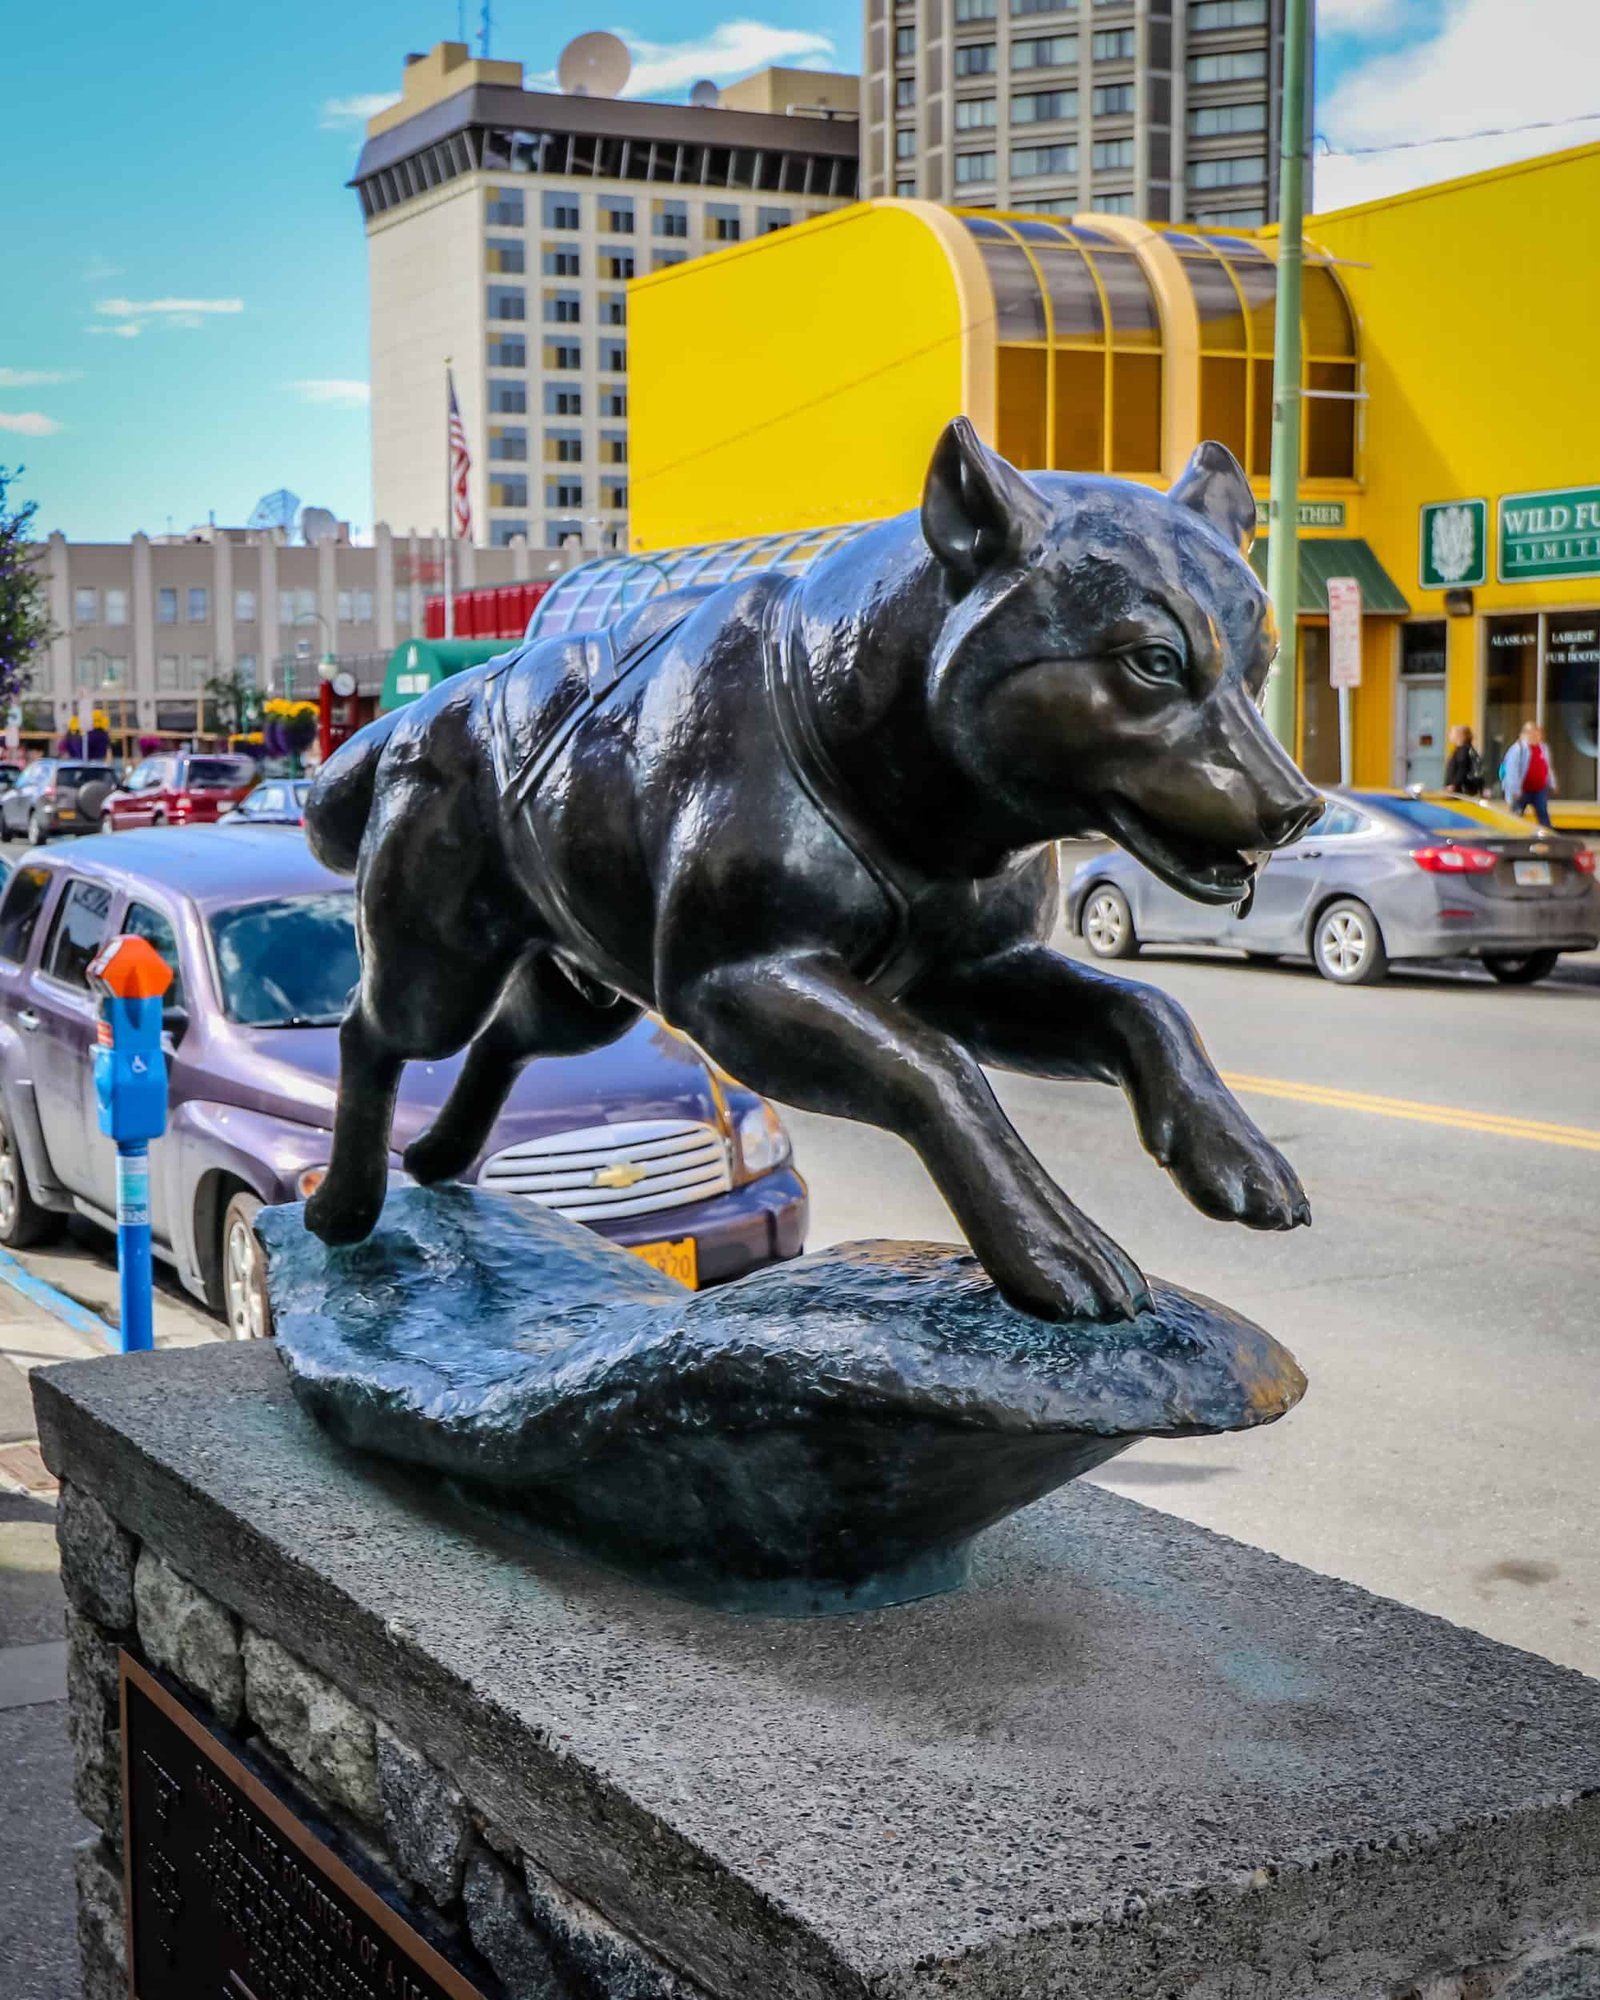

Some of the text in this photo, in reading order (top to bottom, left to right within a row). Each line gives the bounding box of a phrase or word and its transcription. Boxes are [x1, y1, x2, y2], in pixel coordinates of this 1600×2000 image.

[1296, 506, 1341, 523] THER
[1504, 506, 1568, 534] WILD
[1515, 537, 1600, 563] LIMIT
[1551, 629, 1596, 643] LARGEST
